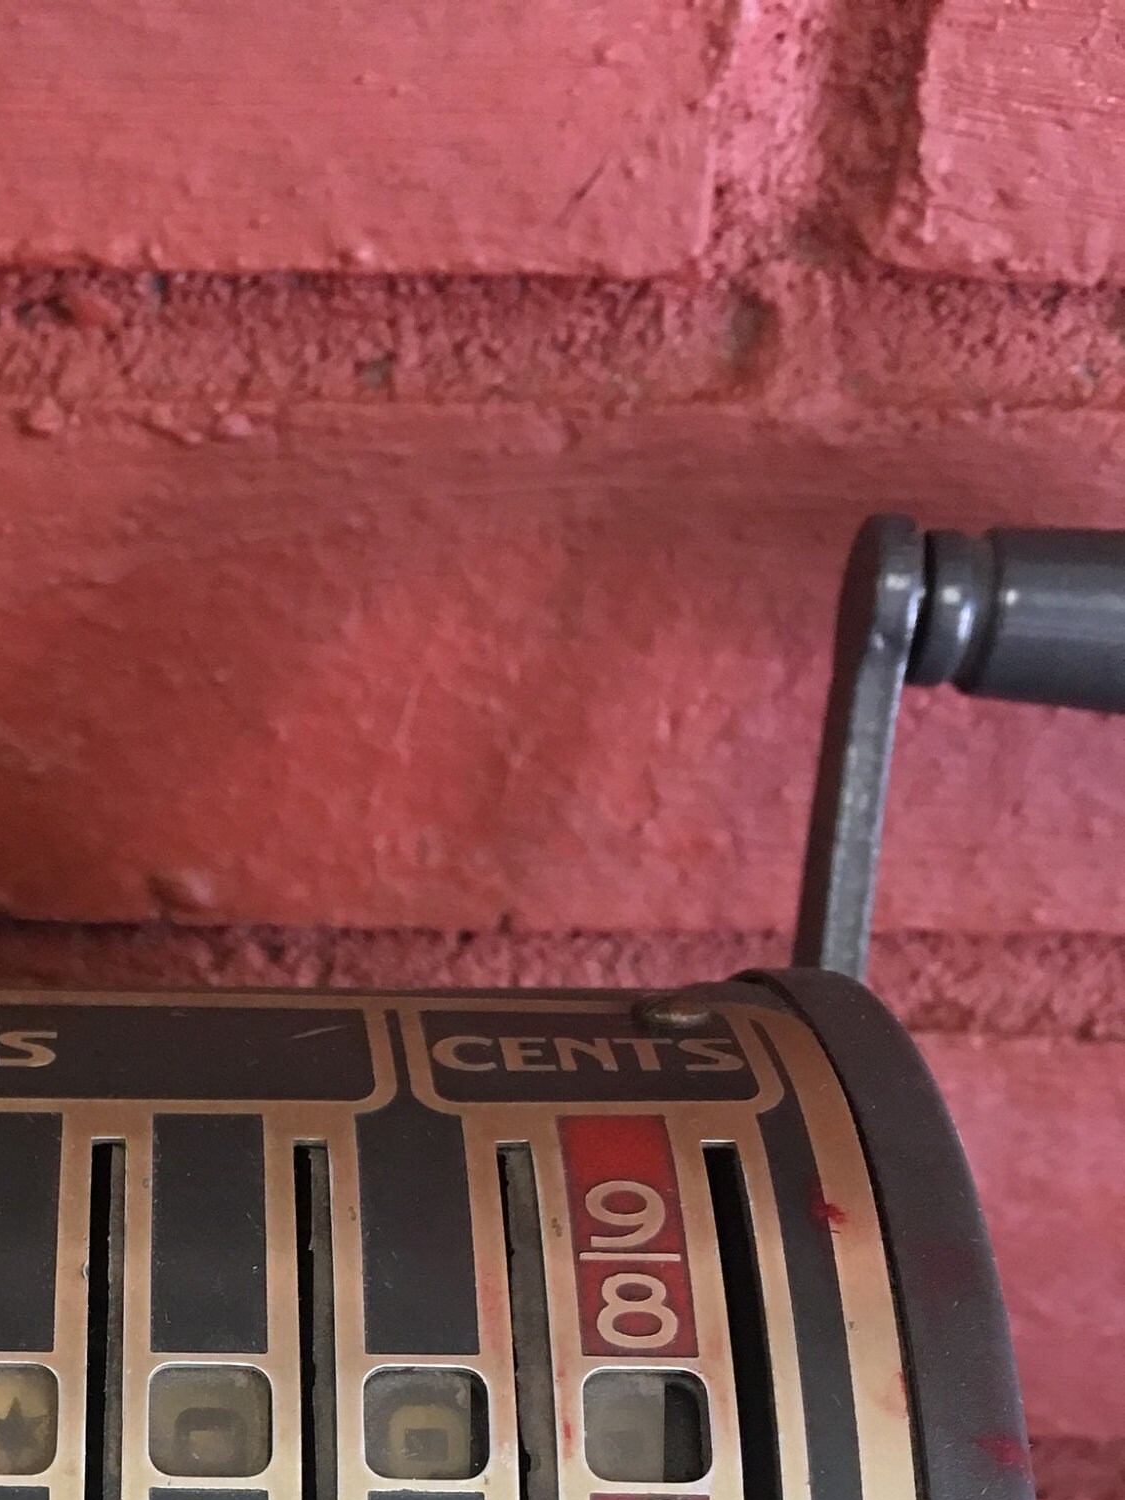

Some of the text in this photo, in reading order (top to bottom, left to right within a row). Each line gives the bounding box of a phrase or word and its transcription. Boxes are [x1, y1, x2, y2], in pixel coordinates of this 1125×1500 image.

[432, 1035, 745, 1072] CENTS
[582, 1181, 667, 1249] 9
[597, 1273, 678, 1348] 8
